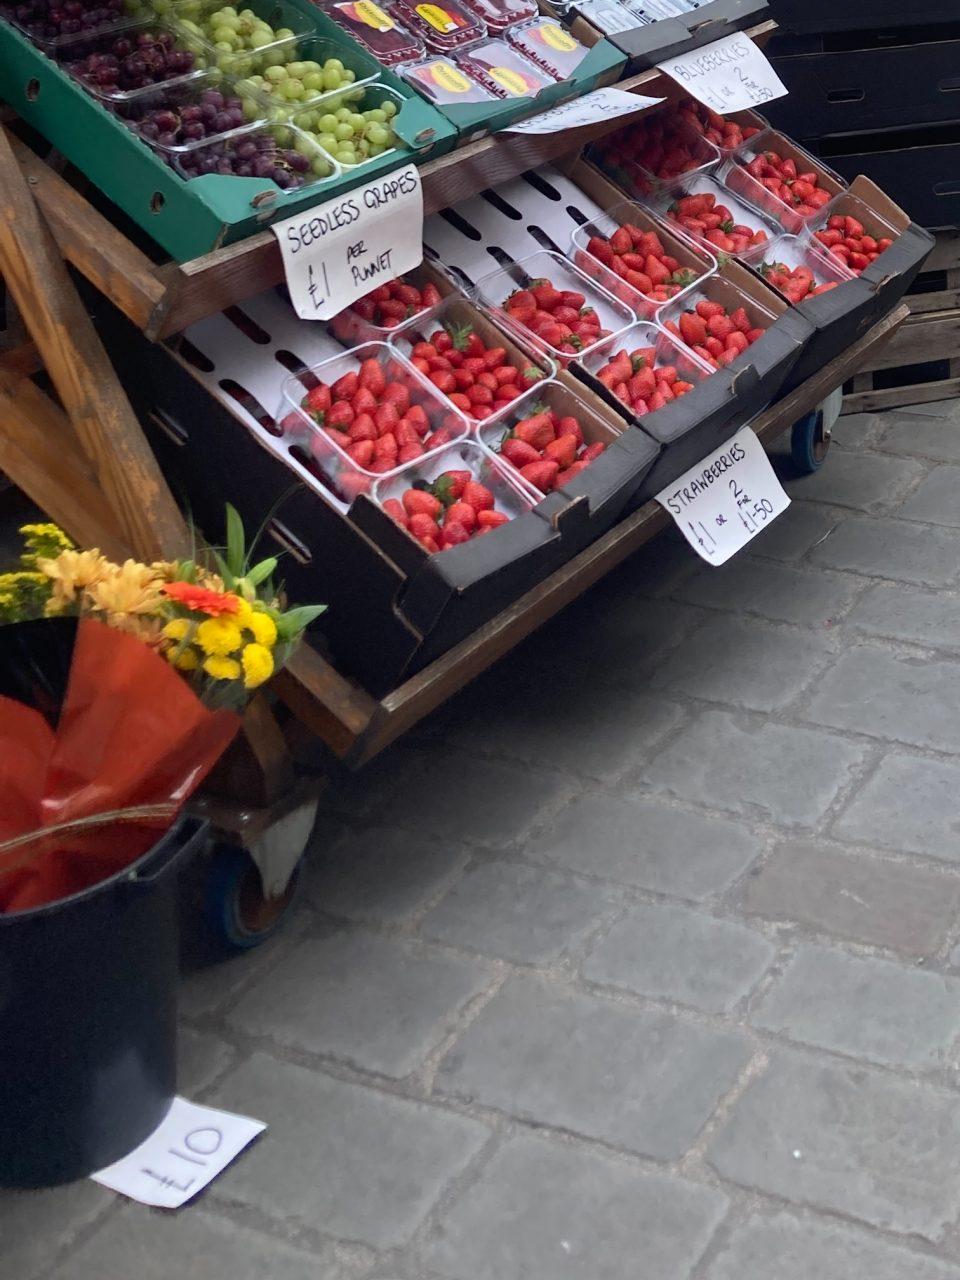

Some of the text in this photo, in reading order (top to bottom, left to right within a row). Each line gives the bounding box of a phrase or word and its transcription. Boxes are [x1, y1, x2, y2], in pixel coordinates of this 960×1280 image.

[674, 41, 750, 81] BLUEBERRIES
[733, 66, 749, 82] 2
[287, 171, 418, 254] SEEDLESS GRAPES
[307, 240, 368, 310] £1 PER
[667, 442, 746, 514] STRAWBERRIES
[728, 479, 743, 498] 2
[688, 514, 728, 556] £1 OR
[140, 1127, 223, 1193] £10
